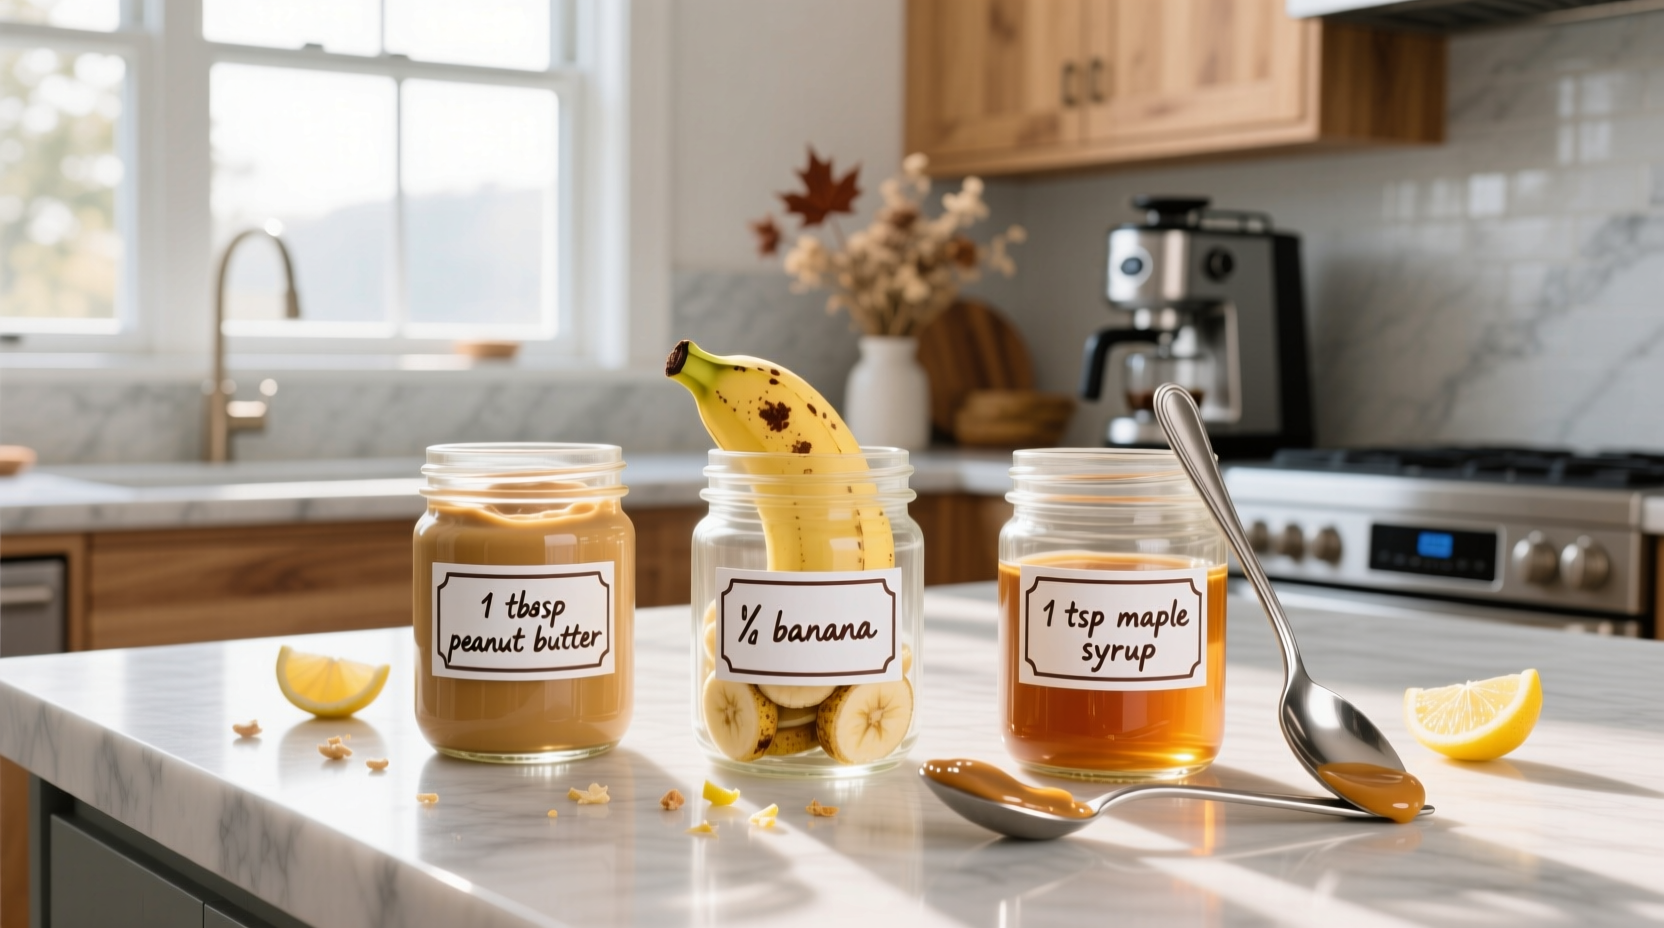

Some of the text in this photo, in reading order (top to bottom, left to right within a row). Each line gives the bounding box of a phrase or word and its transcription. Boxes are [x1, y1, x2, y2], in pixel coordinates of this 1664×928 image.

[480, 591, 494, 619] 1
[1042, 598, 1190, 639] 1 tsp maple
[772, 609, 878, 643] banana
[447, 623, 603, 664] peanut butter
[1081, 642, 1156, 673] syrup
